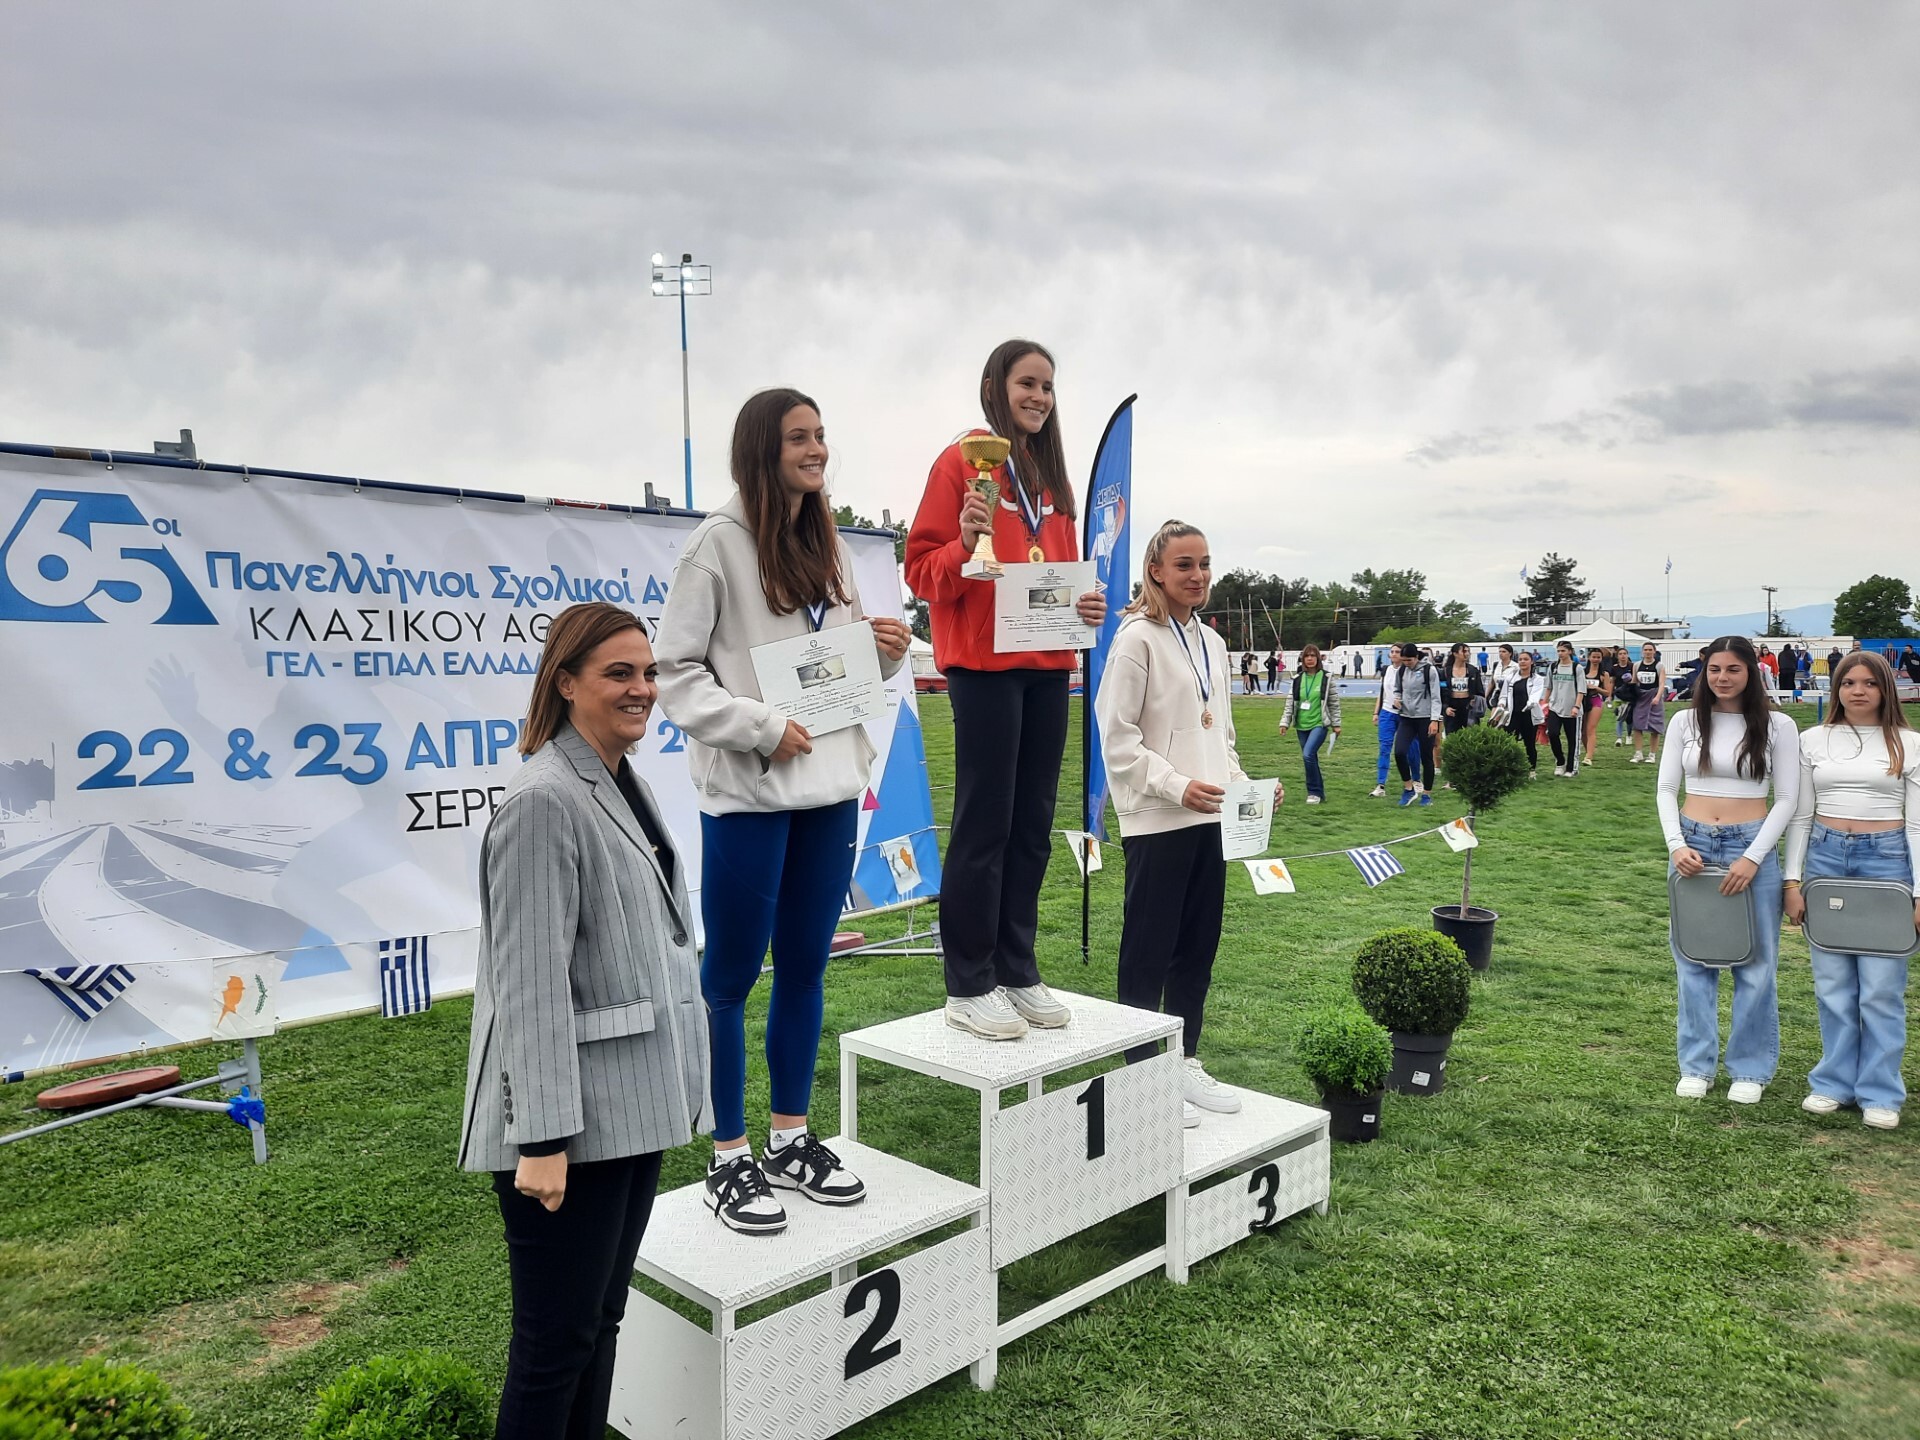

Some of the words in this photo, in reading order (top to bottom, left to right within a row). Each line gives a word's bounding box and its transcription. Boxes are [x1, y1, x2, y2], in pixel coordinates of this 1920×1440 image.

[6, 498, 173, 625] 65
[152, 517, 182, 537] οι
[206, 551, 480, 604] Πανελλήνιοι
[488, 564, 635, 608] Σχολικοί
[250, 606, 486, 643] ΚΛΑΣΙΚΟΥ
[266, 651, 325, 677] ΓΕΛ
[354, 651, 436, 677] ΕΠΑΛ
[76, 728, 194, 790] 22
[224, 727, 272, 781] &
[294, 722, 388, 785] 23
[405, 786, 506, 832] ΣΕΡΡ
[1077, 1075, 1105, 1160] 1
[1247, 1163, 1280, 1235] 3
[843, 1268, 901, 1381] 2
